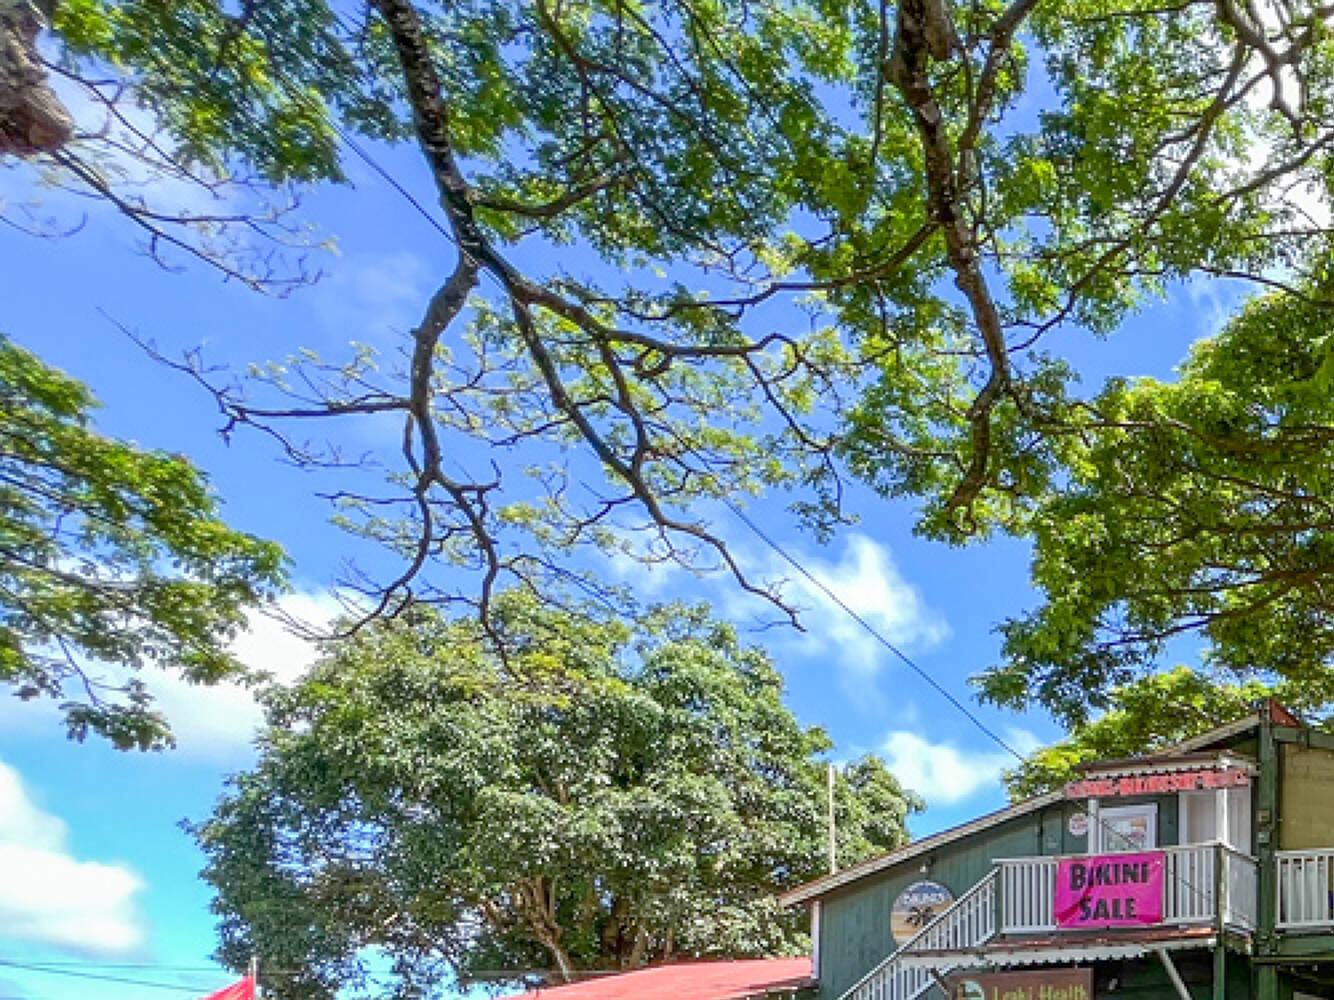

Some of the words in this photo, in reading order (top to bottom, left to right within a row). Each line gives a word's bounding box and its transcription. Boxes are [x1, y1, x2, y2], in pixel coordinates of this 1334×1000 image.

[1070, 862, 1149, 891] BIKINI
[1080, 898, 1137, 920] SALE
[1040, 983, 1089, 1000] Health
